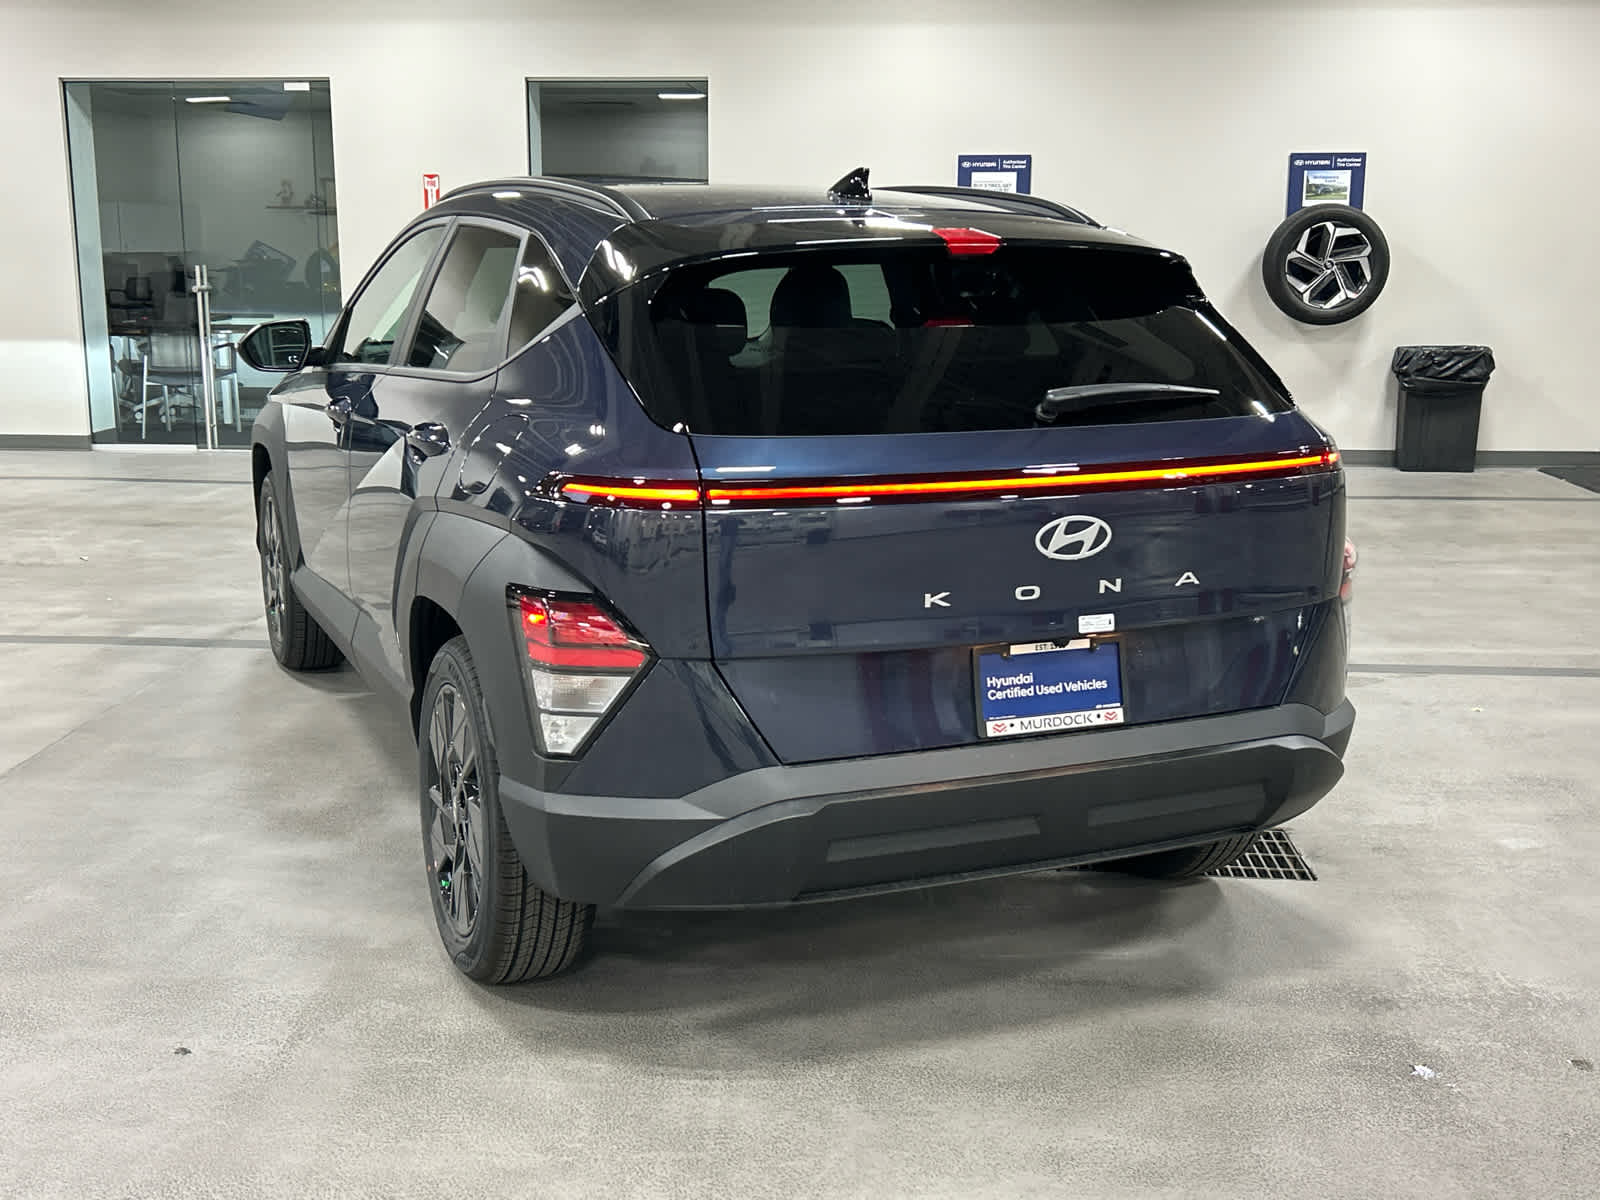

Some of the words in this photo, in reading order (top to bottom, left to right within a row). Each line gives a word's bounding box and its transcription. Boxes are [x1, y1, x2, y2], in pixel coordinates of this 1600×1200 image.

[924, 571, 1200, 608] KONA
[986, 672, 1034, 688] Hyundai
[987, 685, 1035, 701] Certified
[1036, 682, 1063, 695] Used
[1064, 679, 1108, 692] Vehicles
[1019, 713, 1094, 731] MURDOCK
